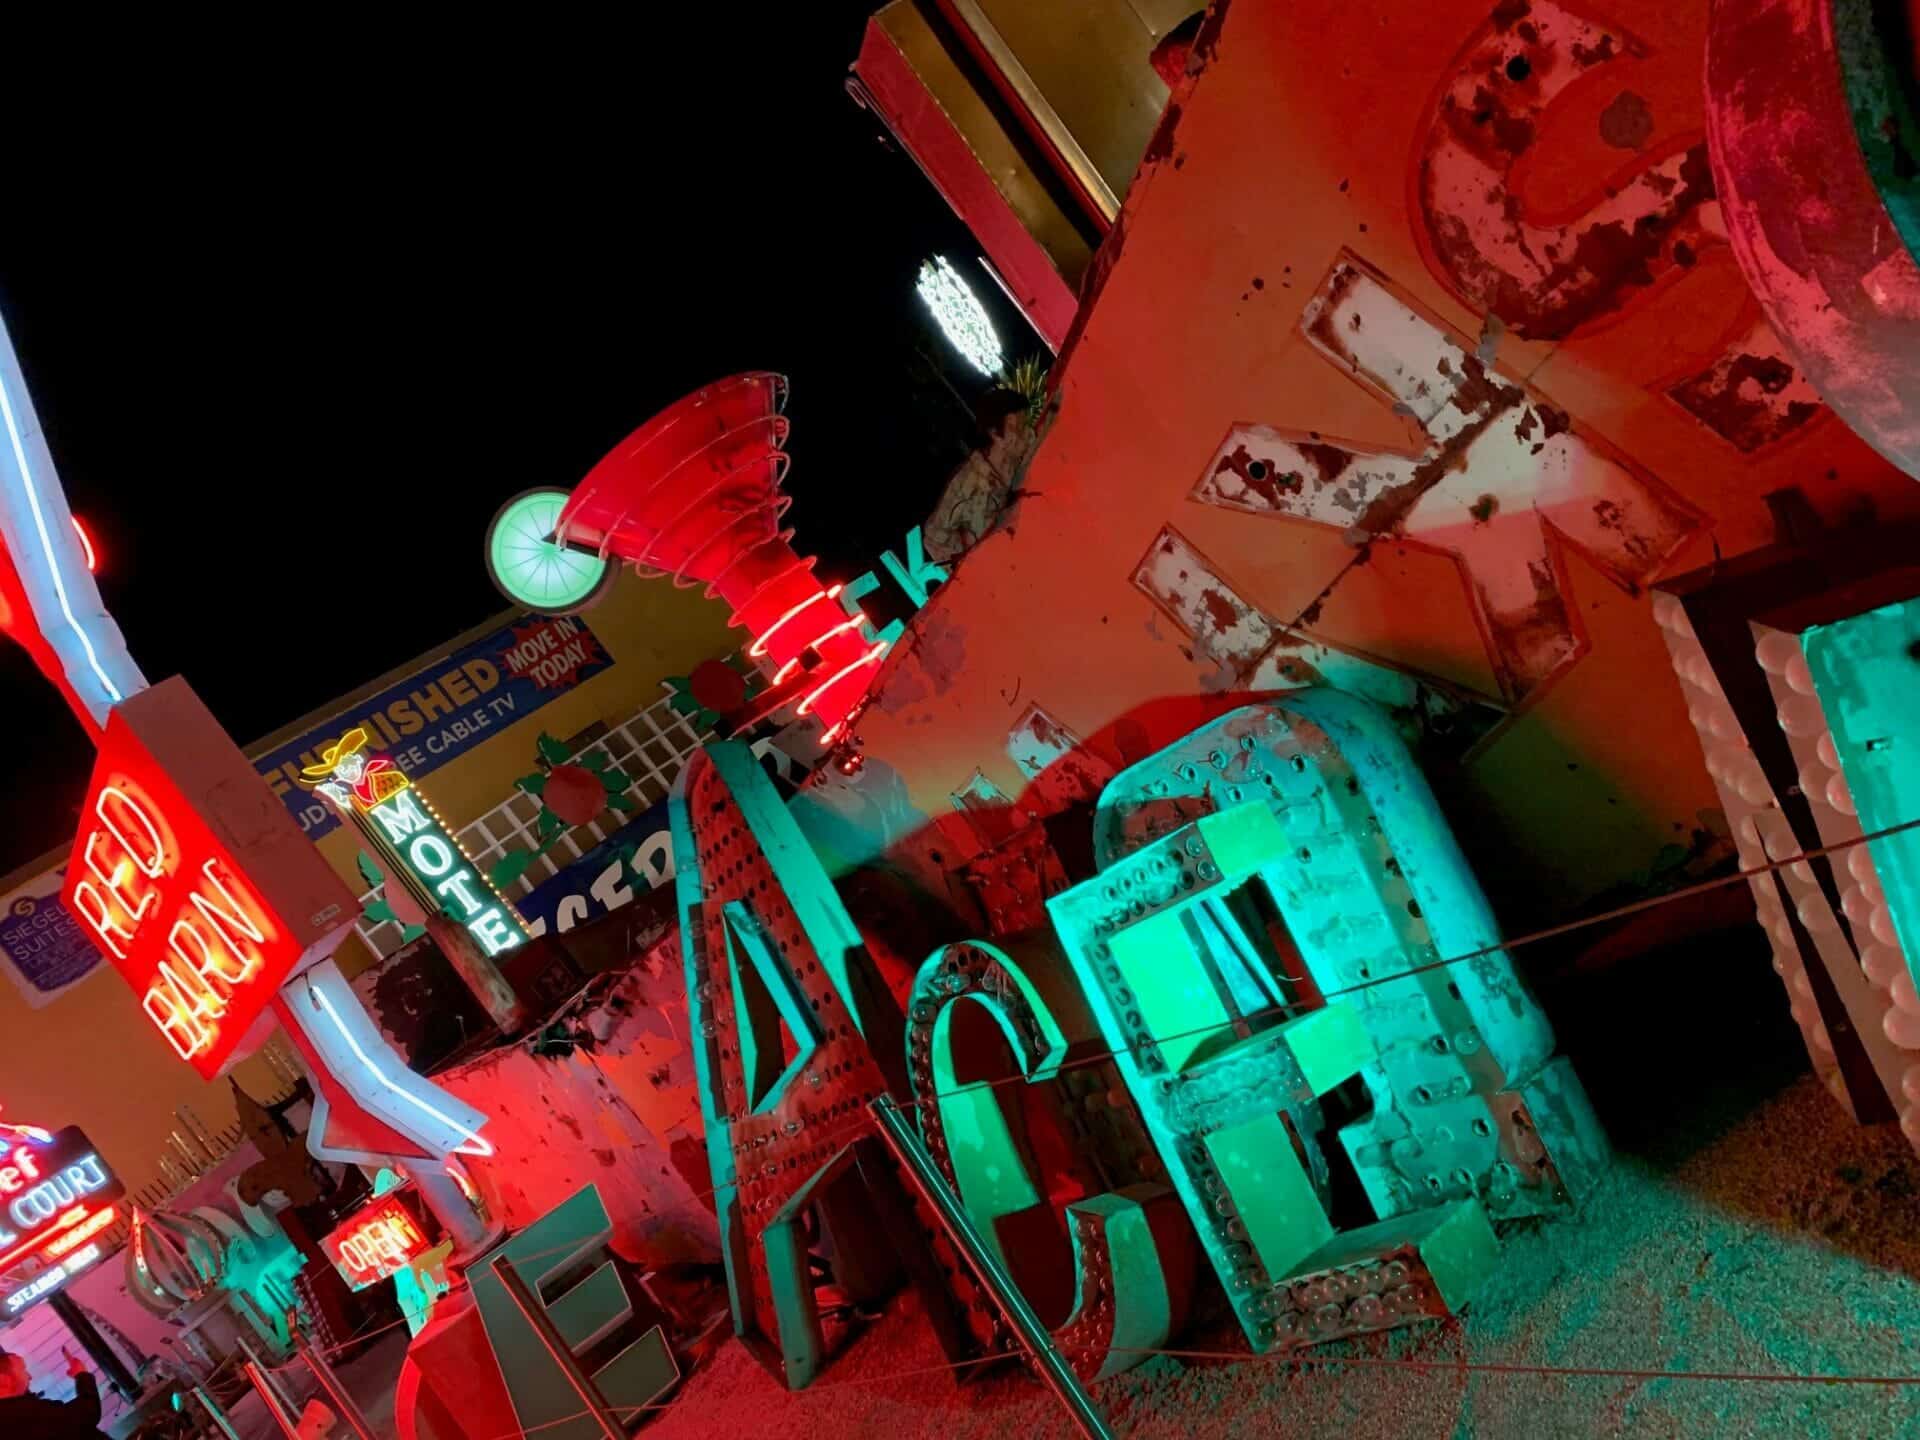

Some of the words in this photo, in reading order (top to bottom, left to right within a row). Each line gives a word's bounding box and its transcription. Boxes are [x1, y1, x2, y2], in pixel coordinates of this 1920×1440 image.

[504, 628, 560, 673] MOVE
[553, 616, 579, 641] IN
[529, 638, 588, 689] TODAY
[425, 707, 492, 754] CABLE
[487, 691, 517, 718] TV
[74, 782, 172, 960] RED
[1, 904, 70, 945] SIEGEL
[142, 859, 272, 1061] BARN
[9, 1152, 109, 1230] COURT
[339, 1209, 421, 1272] OPEN
